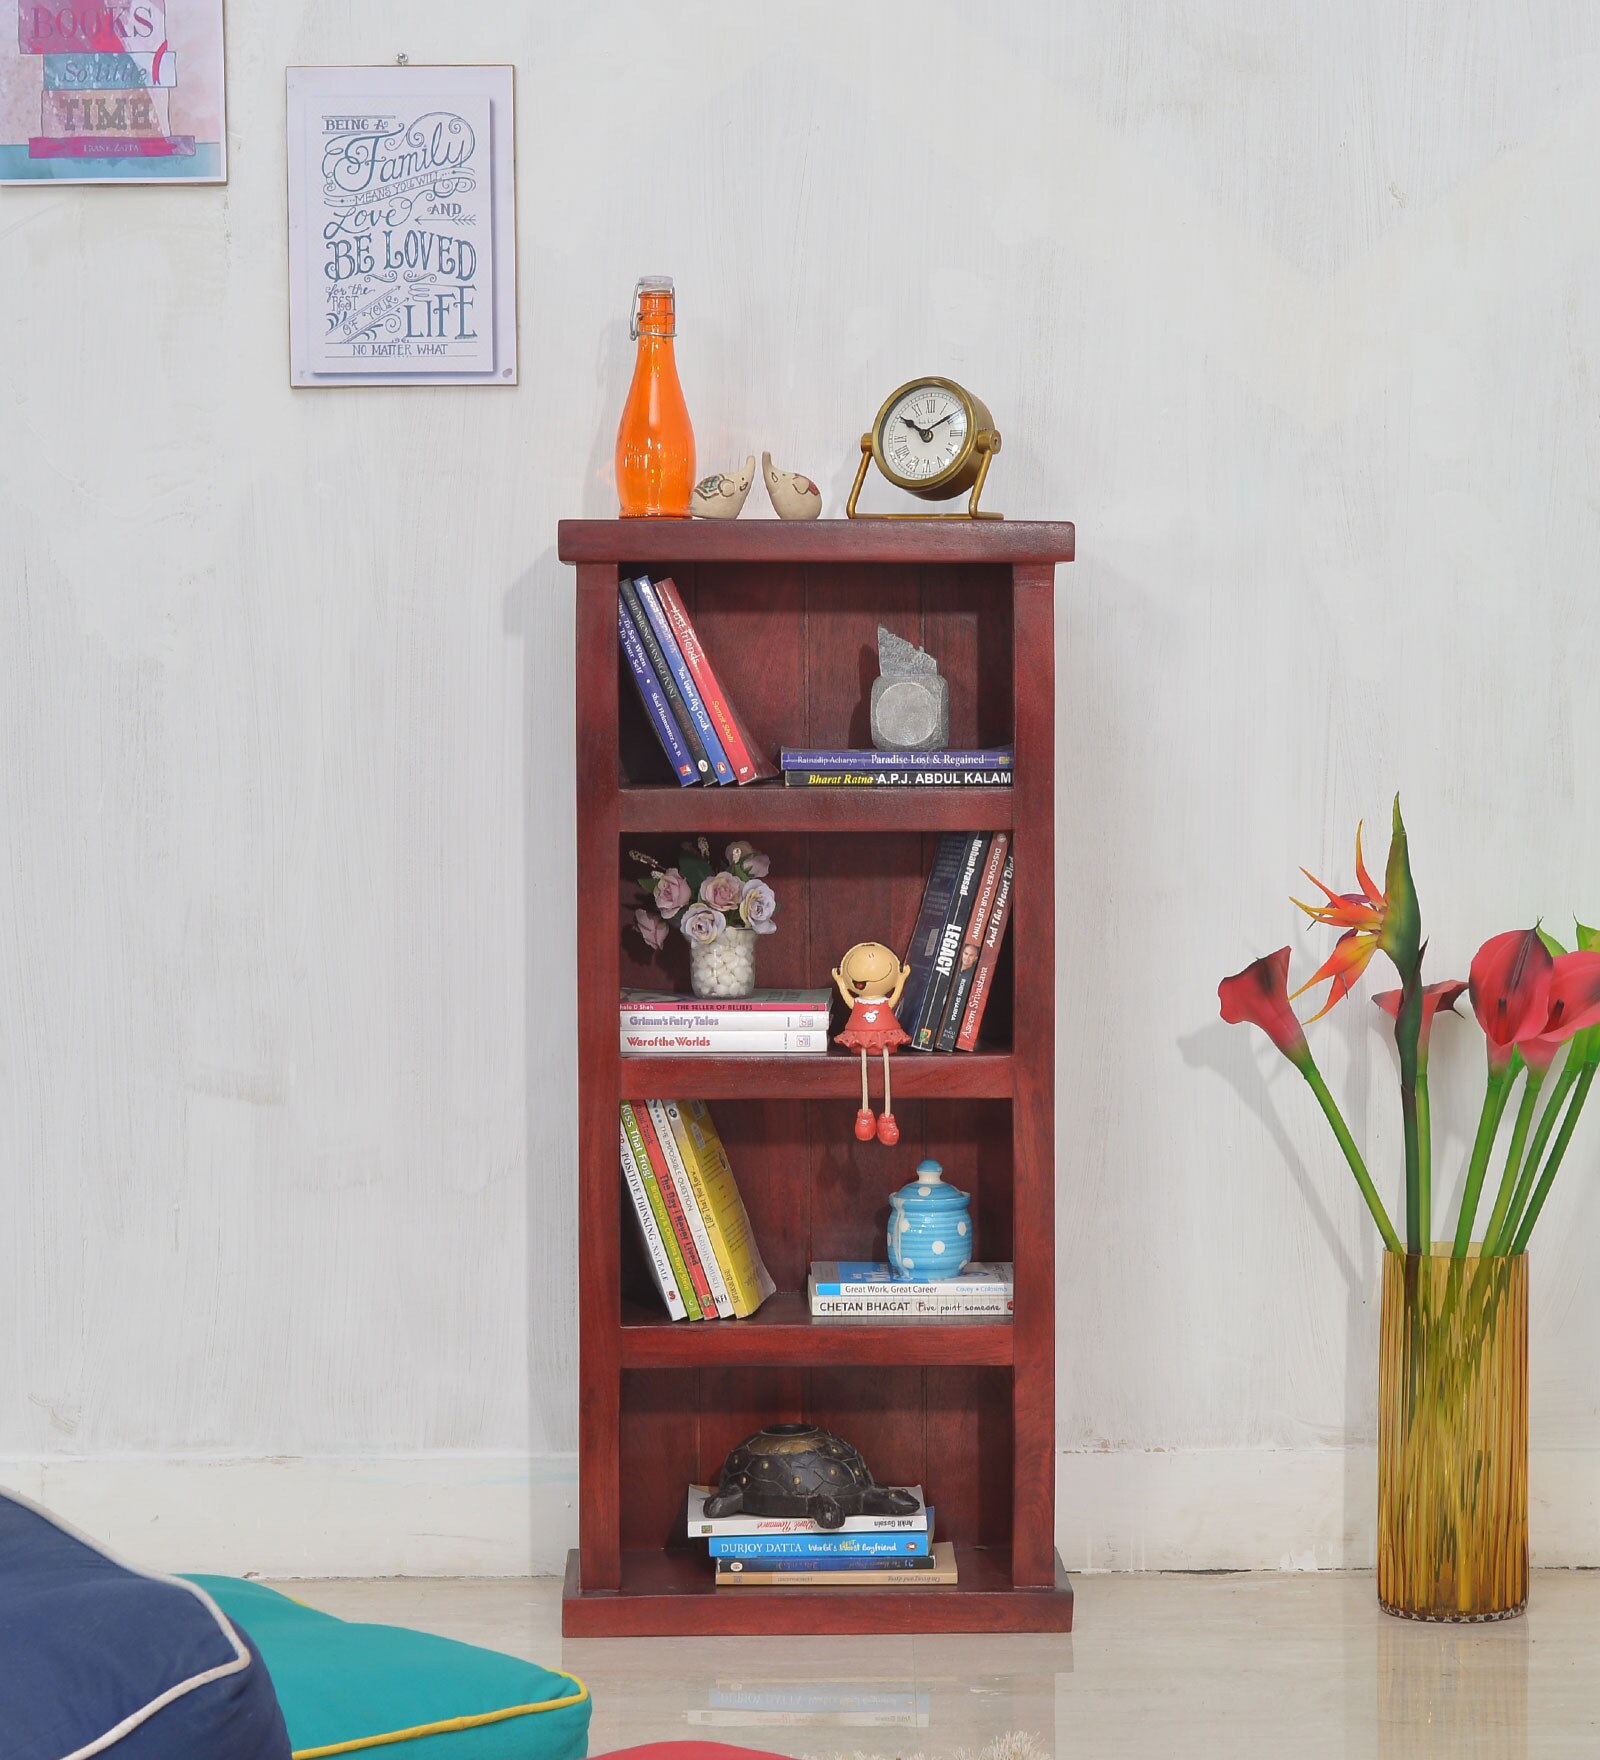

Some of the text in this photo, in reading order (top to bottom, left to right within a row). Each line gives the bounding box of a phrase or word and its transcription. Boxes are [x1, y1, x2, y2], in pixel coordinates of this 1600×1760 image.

[31, 6, 154, 38] BOOKS
[63, 61, 147, 82] So little
[59, 98, 152, 131] TIME
[325, 119, 388, 130] BEING A
[322, 116, 475, 192] Family
[355, 171, 442, 206] MEANS YOU WILL
[323, 198, 462, 240] Love AND
[324, 230, 477, 283] BE LOVED
[326, 284, 375, 302] for the
[342, 295, 399, 335] OF YOUR
[403, 285, 477, 338] LIFE
[352, 344, 448, 355] NO MATTER WHAT
[618, 626, 629, 639] To
[622, 617, 633, 629] To
[625, 628, 639, 644] Say
[623, 638, 637, 659] Your
[633, 610, 654, 643] WRONG
[646, 641, 668, 677] VANTAGE
[661, 675, 677, 699] POINT
[633, 643, 648, 667] When
[631, 658, 644, 675] Self
[676, 665, 688, 680] You
[682, 679, 695, 697] Were
[650, 691, 662, 708] Shad
[687, 696, 700, 712] My
[871, 754, 909, 765] Paradise
[910, 754, 930, 765] Lost
[932, 754, 941, 765] &
[943, 754, 985, 766] Regained
[808, 772, 1012, 785] Bharat Ratna A.P.J. ABDUL KALAM
[958, 838, 983, 896] Mohan Prasad
[969, 847, 1002, 940] DISCOVER YOUR DESTINY
[995, 879, 1010, 907] Heart
[991, 908, 1003, 925] The
[985, 925, 999, 948] And
[933, 922, 963, 976] LEGACY
[956, 977, 966, 996] ROBIN
[949, 996, 962, 1021] SHARMA
[960, 965, 988, 1038] Aseem Srivastava
[629, 1016, 719, 1028] Grimm's Fairy Tales
[626, 1036, 711, 1047] War of the Worlds
[620, 1103, 636, 1127] Kiss
[628, 1128, 644, 1153] That
[636, 1153, 653, 1180] Frog!
[659, 1124, 694, 1211] THE IMPOSSIBLE QUESTION
[659, 1173, 672, 1190] The
[664, 1191, 678, 1209] Day
[621, 1152, 641, 1194] POSITIVE
[635, 1194, 657, 1241] THINKING
[655, 1258, 669, 1282] PEALE
[674, 1215, 690, 1241] Never
[683, 1241, 699, 1266] Lived
[845, 1285, 866, 1293] Great
[867, 1285, 889, 1294] Work,
[891, 1285, 912, 1293] Great
[914, 1285, 937, 1293] Career
[820, 1302, 863, 1311] CHETAN
[866, 1302, 910, 1311] BHAGAT
[918, 1302, 936, 1312] Five
[940, 1303, 962, 1314] point
[756, 1520, 792, 1532] Romance
[721, 1543, 764, 1553] DURJOY
[766, 1543, 802, 1553] DATTA
[808, 1544, 837, 1552] World's
